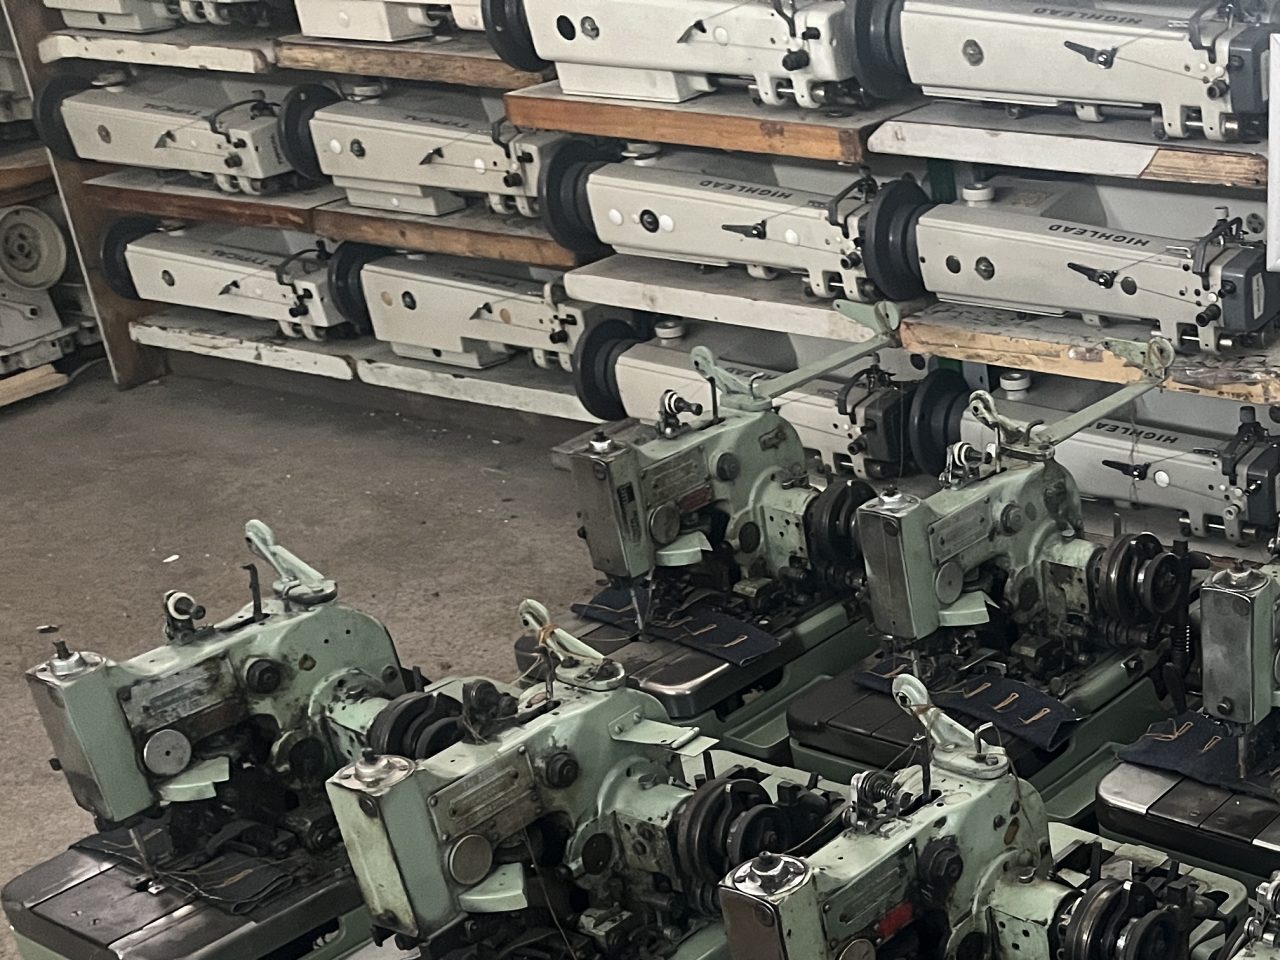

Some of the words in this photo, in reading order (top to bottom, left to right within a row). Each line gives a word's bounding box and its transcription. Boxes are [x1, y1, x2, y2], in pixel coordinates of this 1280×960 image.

[1033, 7, 1143, 26] HIGHLEAD
[699, 180, 793, 200] HIGHLEAD
[1049, 224, 1151, 246] HIGHLEAD
[1087, 421, 1179, 444] HIGHLEA
